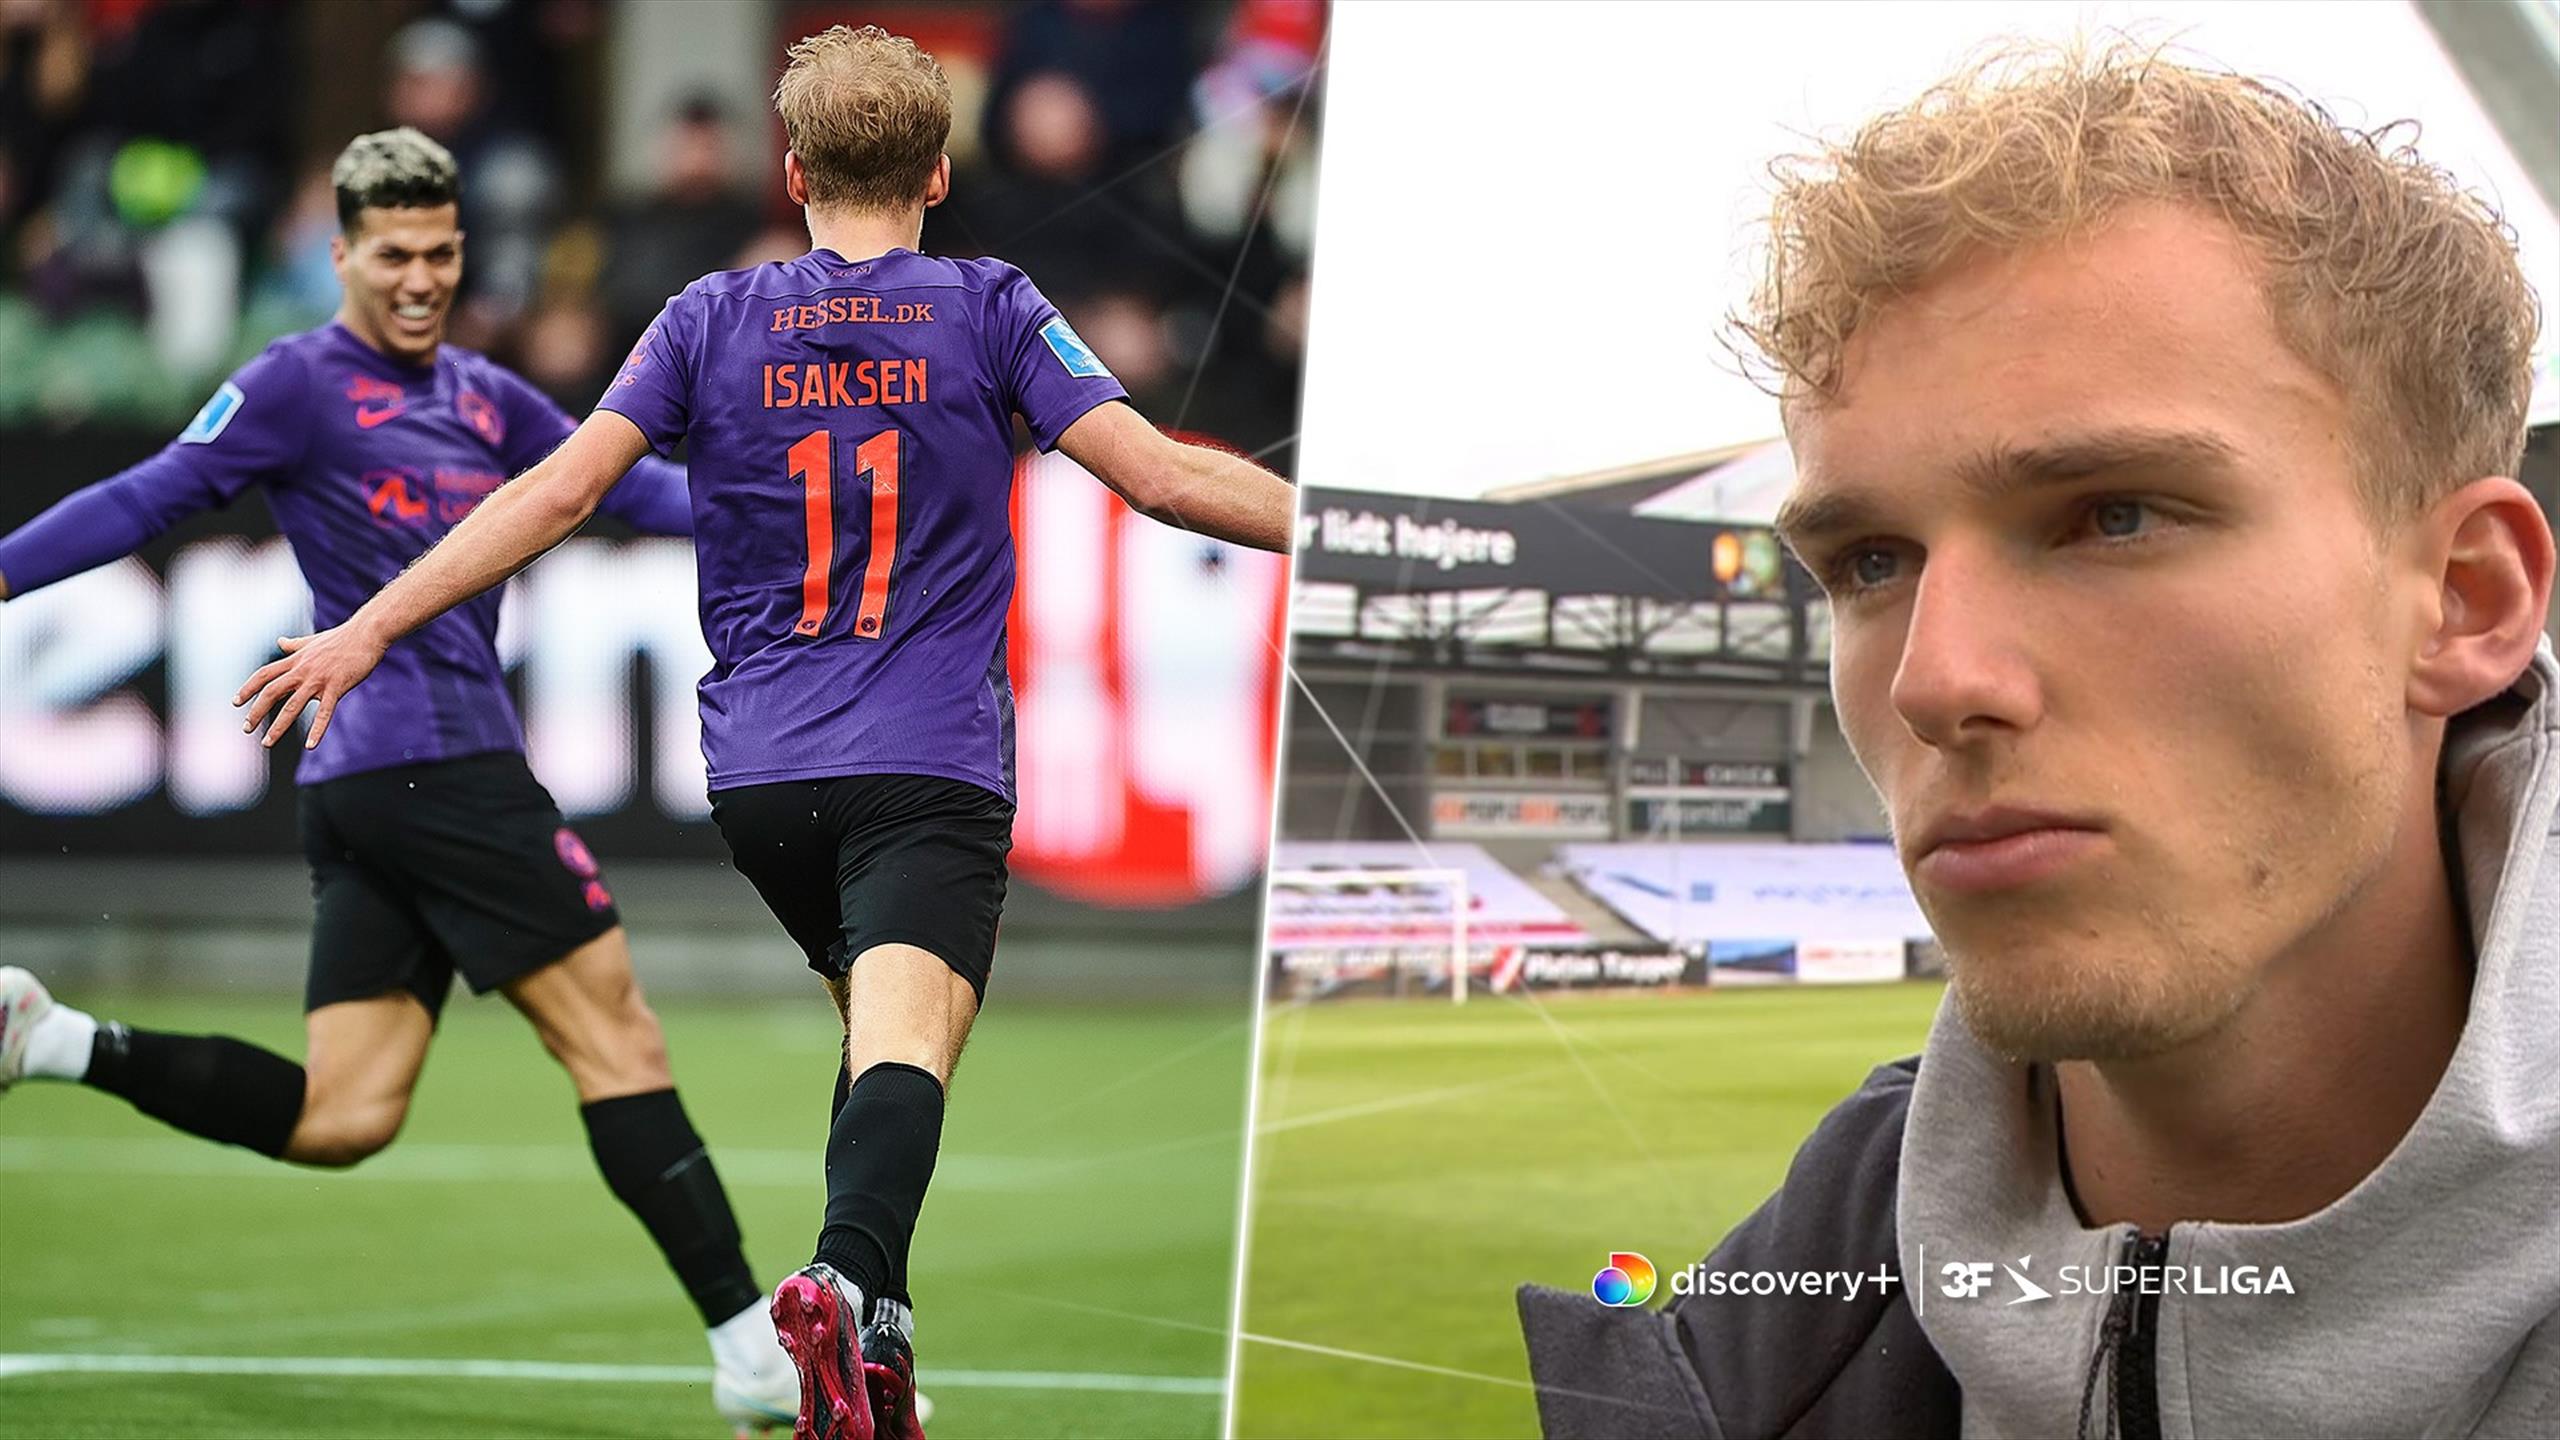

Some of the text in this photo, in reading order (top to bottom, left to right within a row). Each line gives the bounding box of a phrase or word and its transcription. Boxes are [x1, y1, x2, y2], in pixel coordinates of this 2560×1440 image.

[770, 296, 934, 332] HESSEL.DK
[763, 357, 928, 409] ISAKSEN
[787, 429, 903, 640] 11
